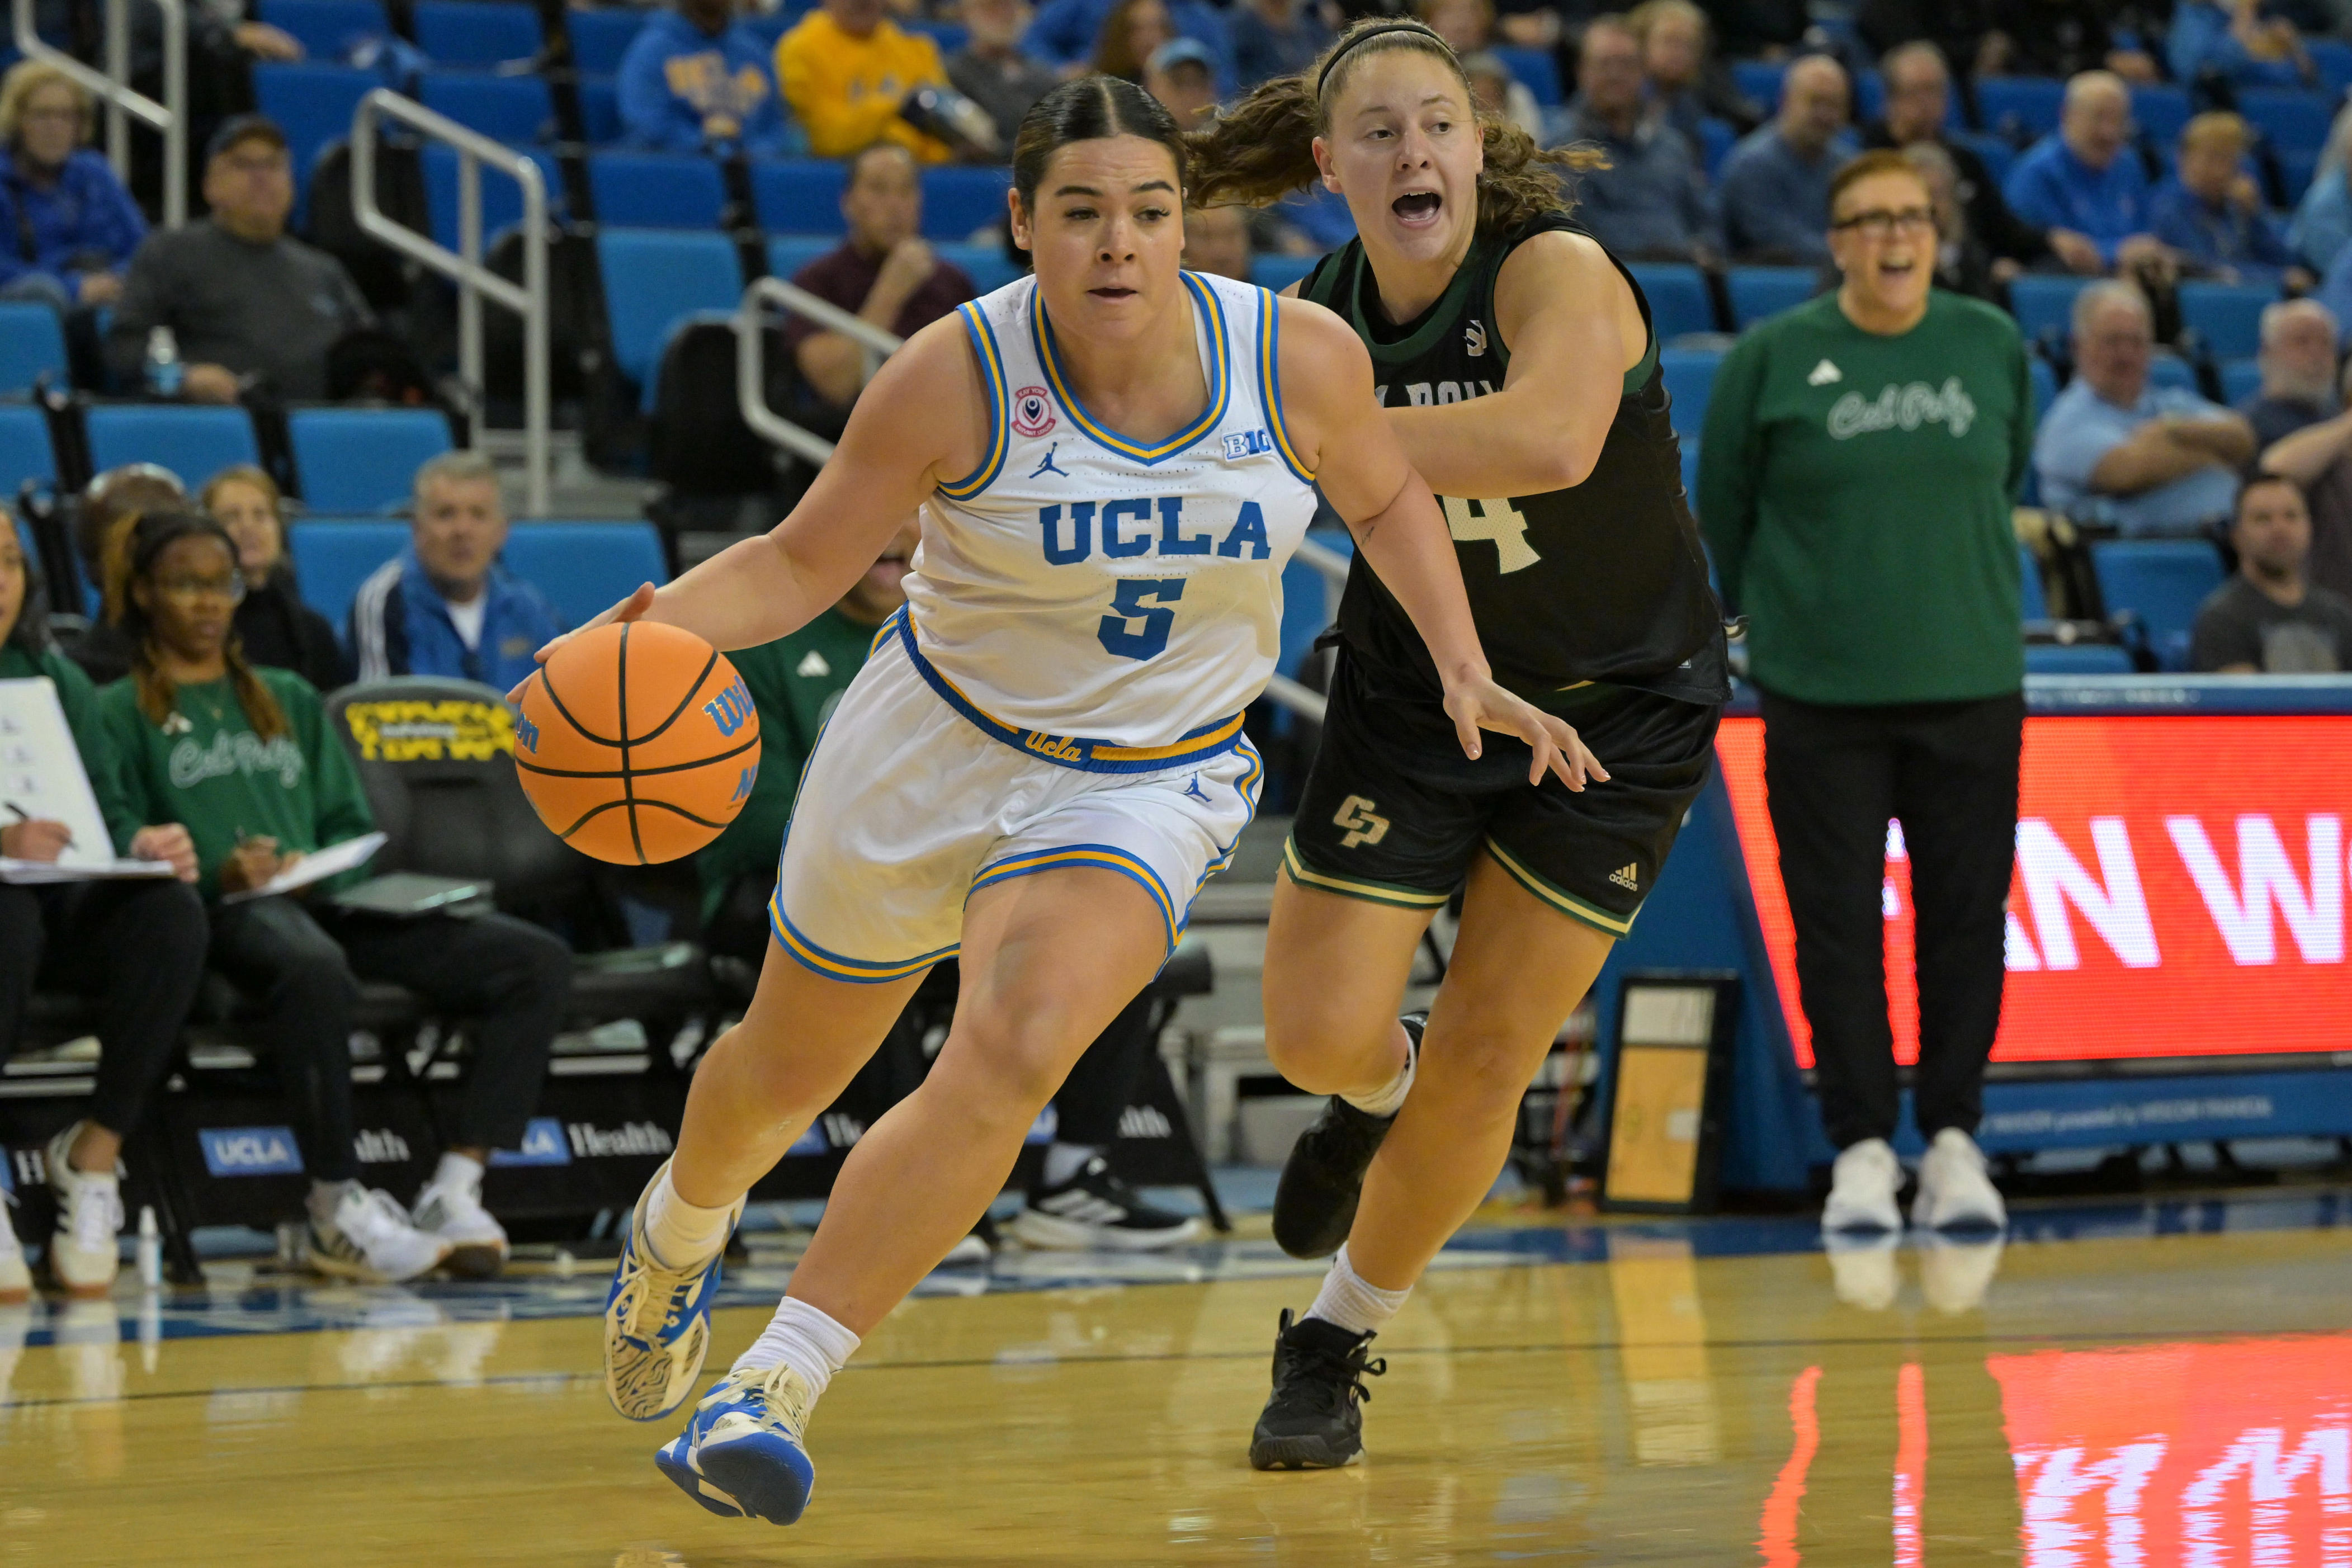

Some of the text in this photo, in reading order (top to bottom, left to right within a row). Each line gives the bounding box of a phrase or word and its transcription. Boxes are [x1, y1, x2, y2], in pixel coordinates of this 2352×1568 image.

[1018, 388, 1030, 397] KAY
[1040, 497, 1271, 565] UCLA
[1097, 578, 1187, 661] 5
[1025, 730, 1081, 762] Ucla
[1333, 795, 1390, 848] CP
[1609, 873, 1637, 891] adidas
[215, 1136, 289, 1165] UCLA
[568, 1122, 672, 1156] Health
